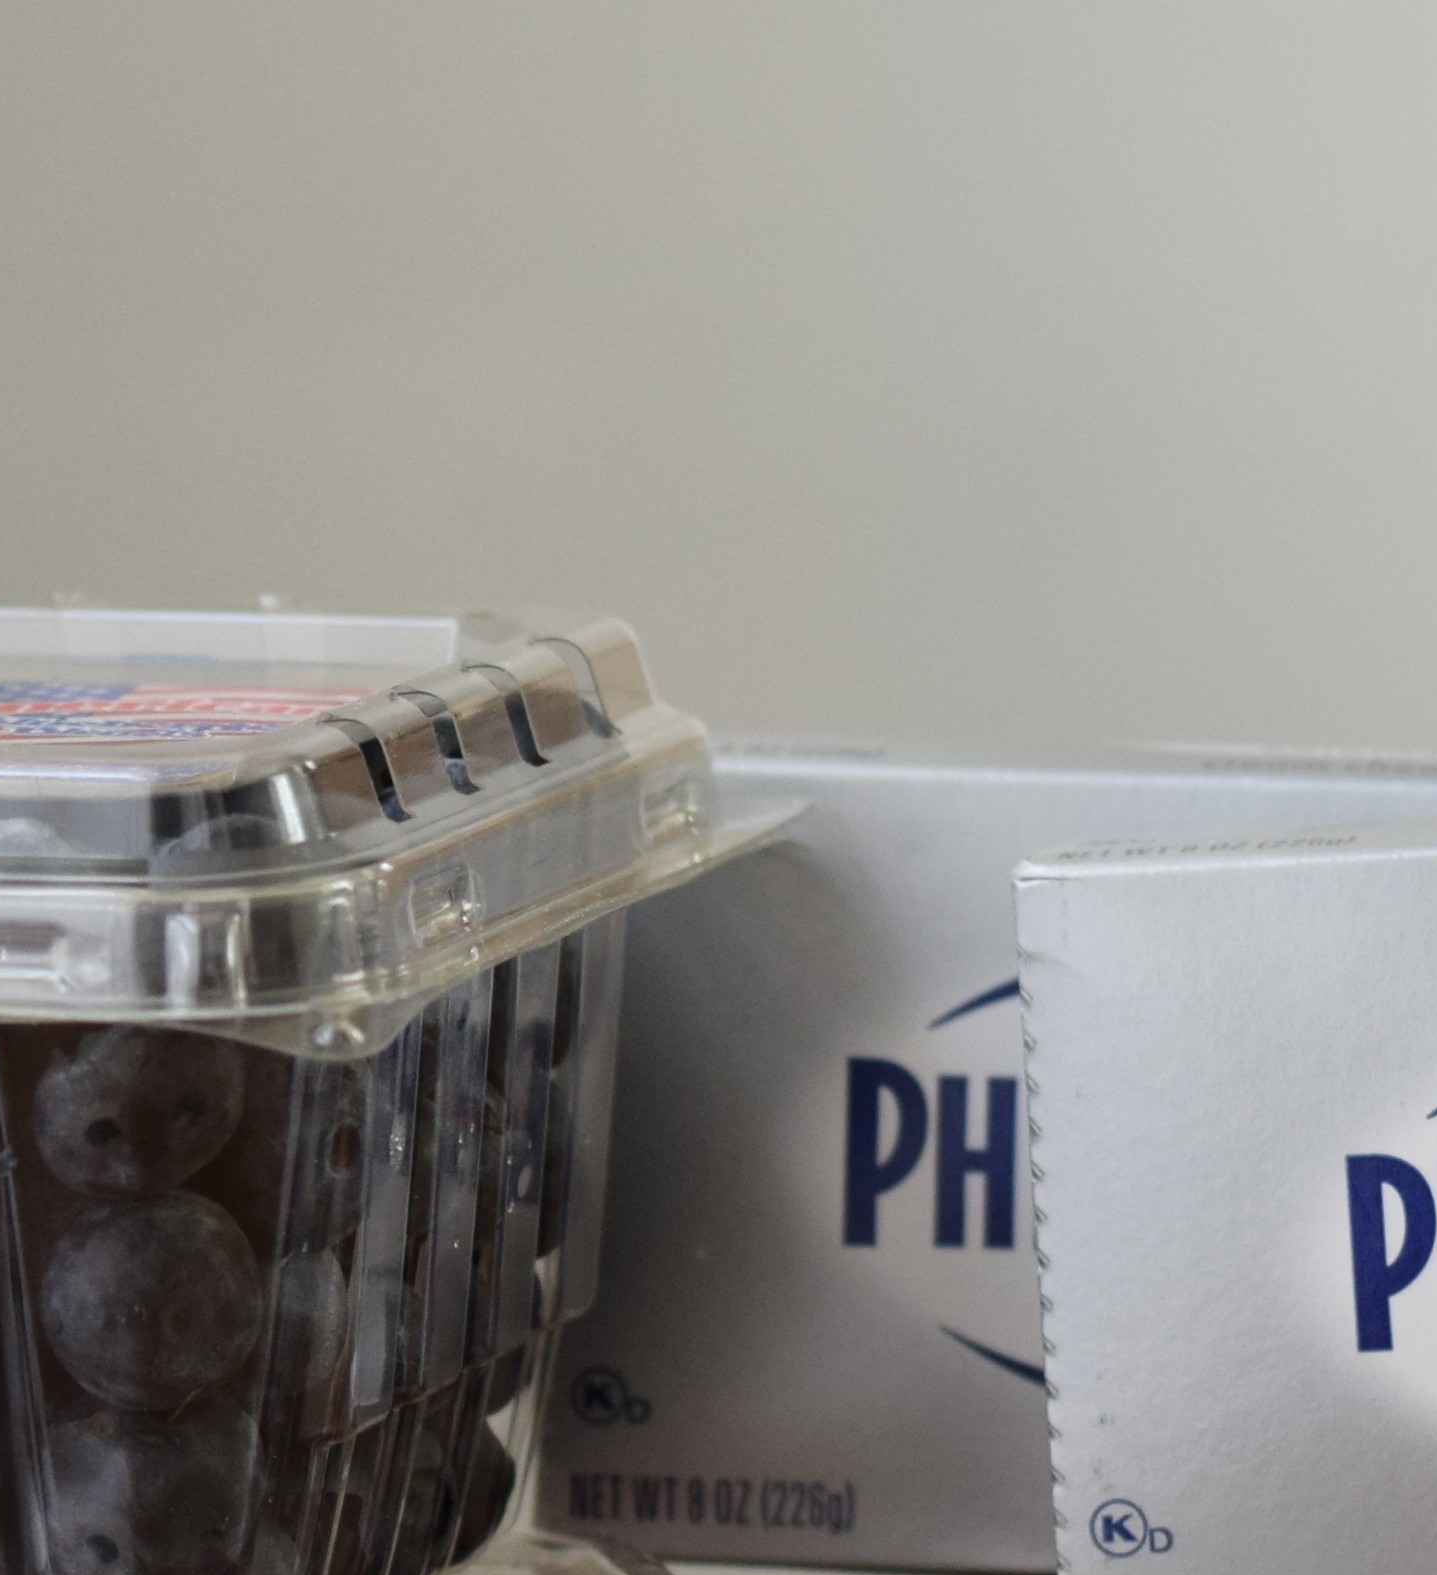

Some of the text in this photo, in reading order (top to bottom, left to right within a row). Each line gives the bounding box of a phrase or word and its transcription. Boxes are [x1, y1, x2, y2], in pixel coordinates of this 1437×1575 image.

[842, 1056, 1018, 1249] PH
[569, 1472, 622, 1520] NET
[633, 1475, 677, 1522] WT
